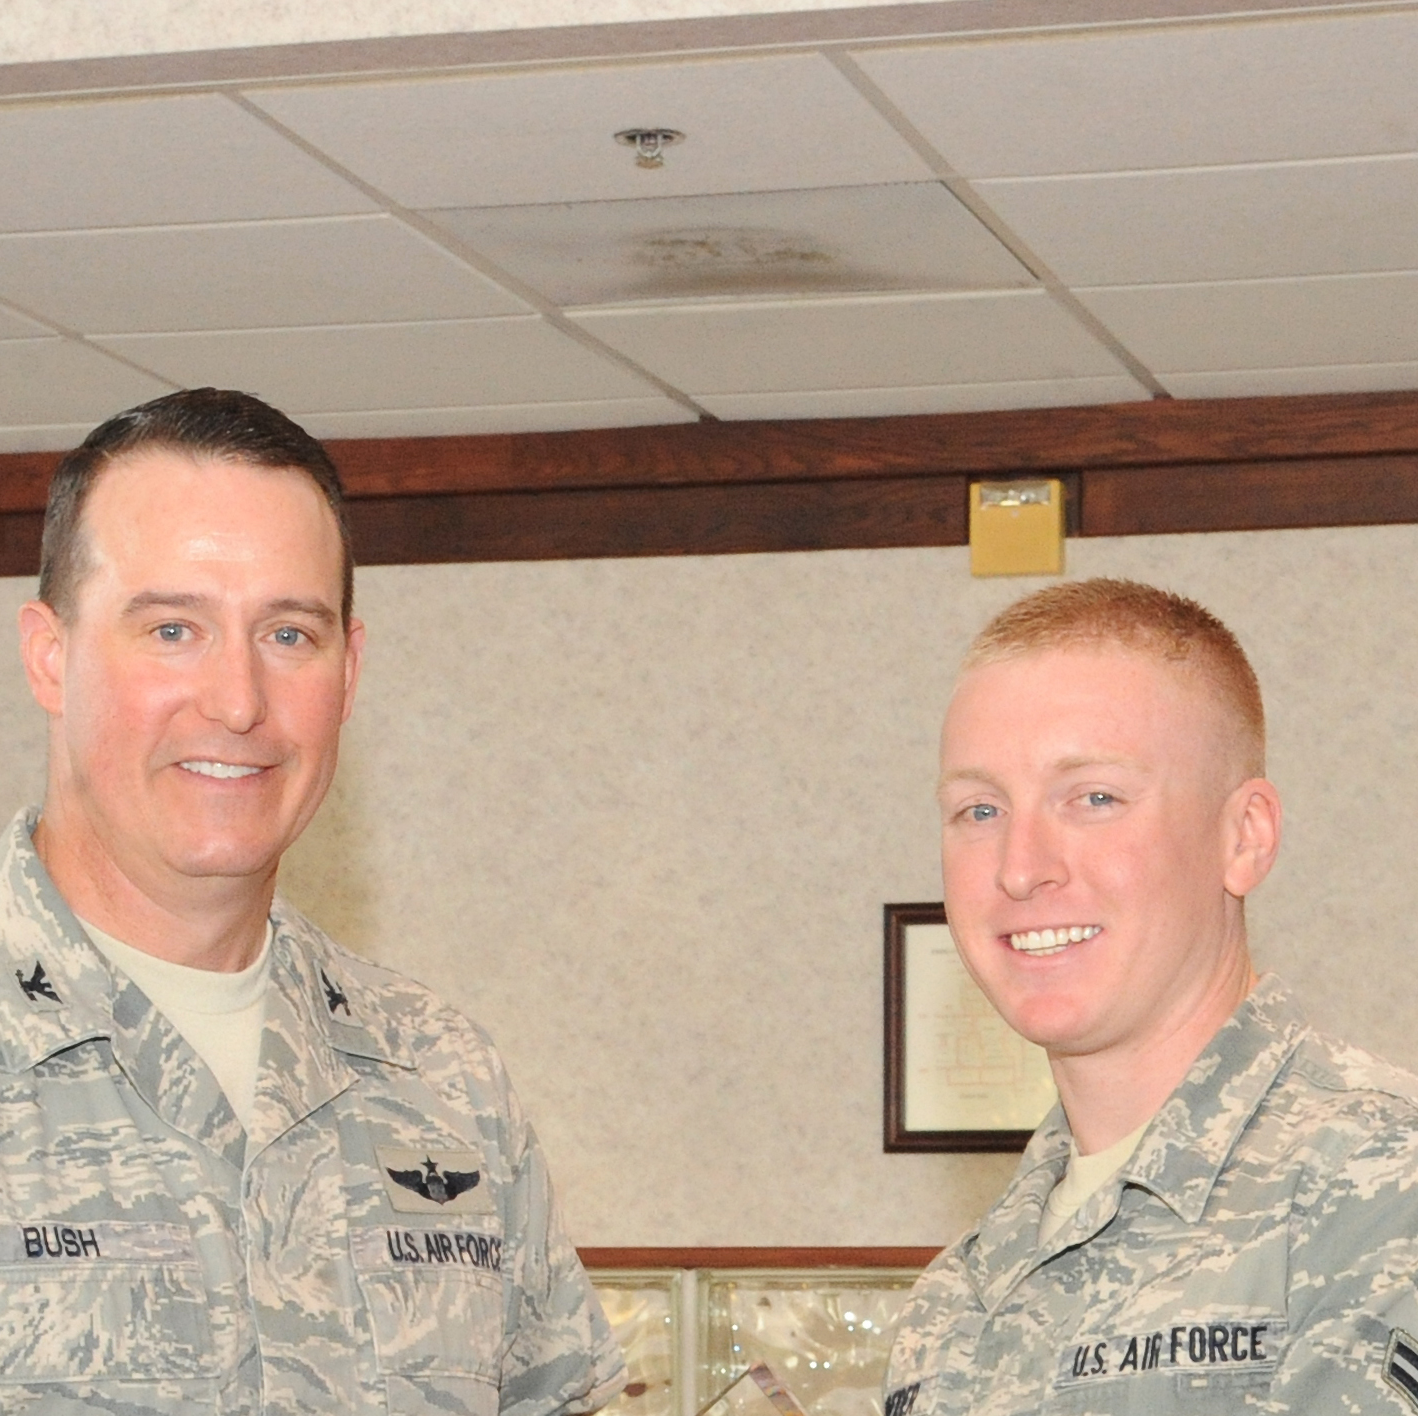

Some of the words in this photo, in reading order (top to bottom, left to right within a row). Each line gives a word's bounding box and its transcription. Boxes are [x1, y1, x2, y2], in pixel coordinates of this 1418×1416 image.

[23, 1226, 100, 1259] BUSH
[386, 1230, 424, 1263] U.S.
[424, 1232, 457, 1263] AIR
[1072, 1342, 1108, 1378] U.S.
[1119, 1332, 1161, 1371] AIR
[1169, 1325, 1268, 1364] FORCE
